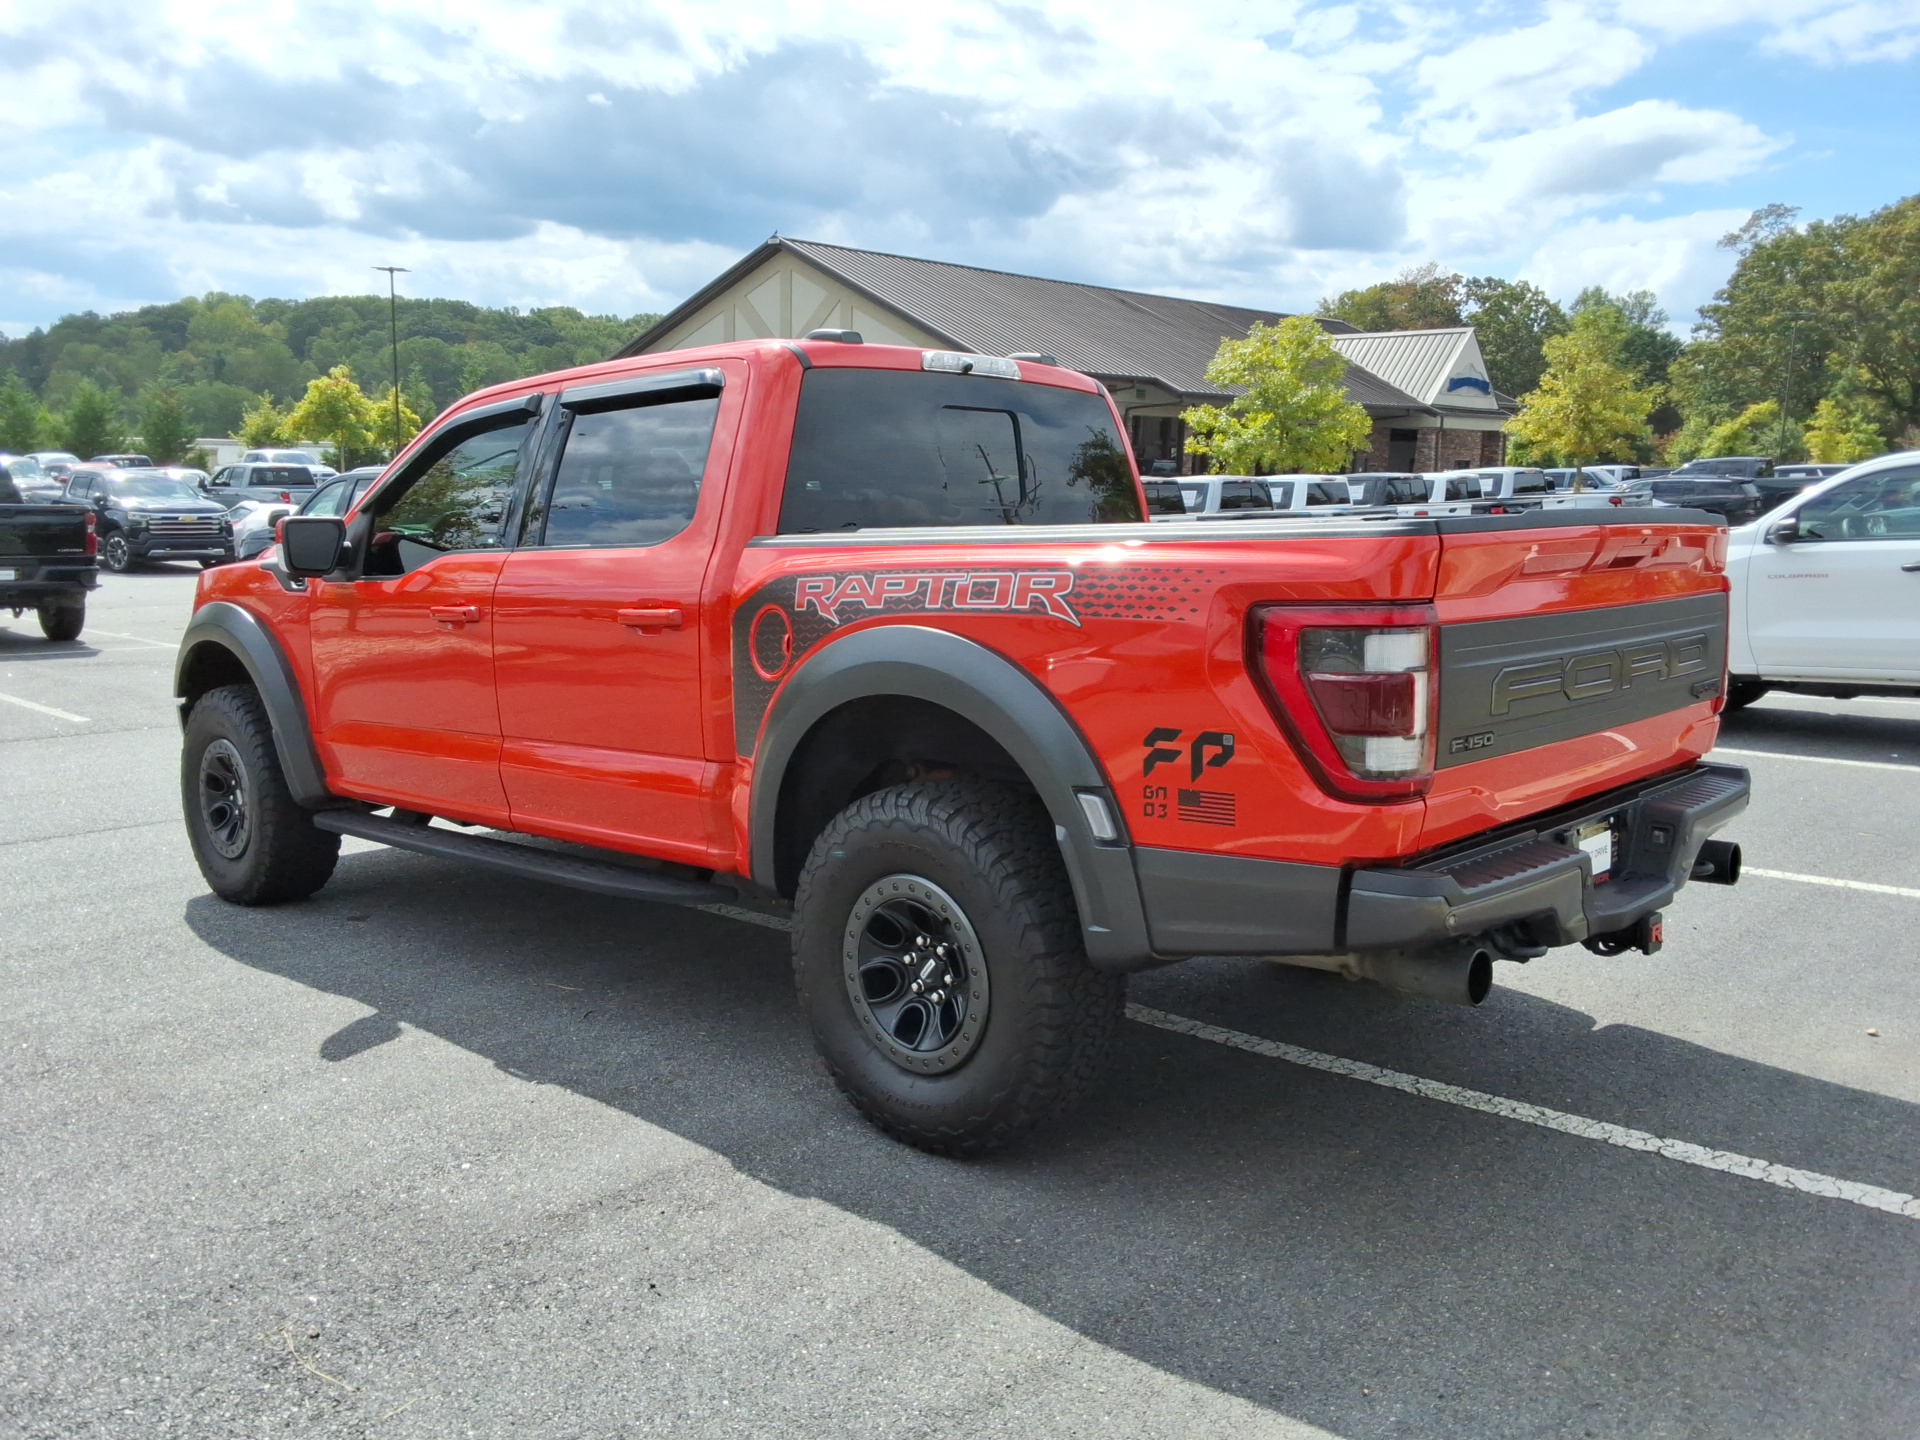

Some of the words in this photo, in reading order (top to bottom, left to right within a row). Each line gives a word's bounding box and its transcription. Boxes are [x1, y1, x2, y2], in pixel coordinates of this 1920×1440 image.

[794, 571, 1083, 627] RAPTOR
[1491, 633, 1708, 716] FORD
[1450, 732, 1494, 753] F-150
